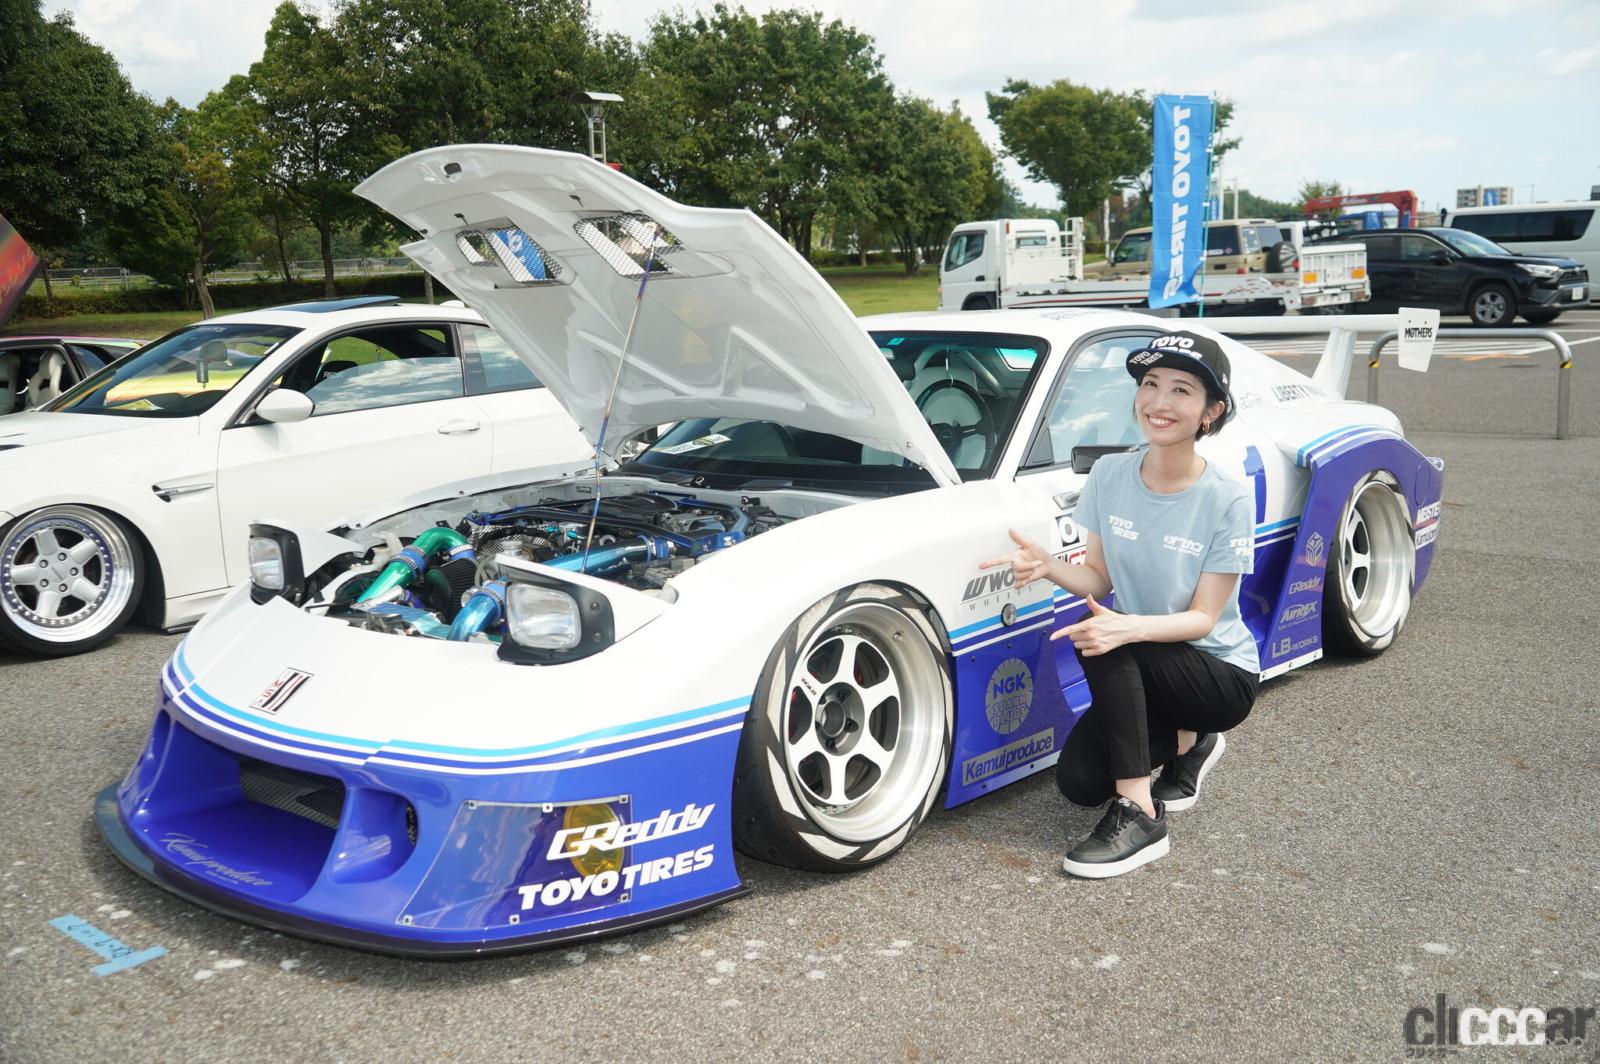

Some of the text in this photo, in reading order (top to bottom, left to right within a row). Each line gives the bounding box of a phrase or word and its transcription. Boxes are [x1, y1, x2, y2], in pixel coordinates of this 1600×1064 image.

[1404, 327, 1433, 339] MOTHERS
[1150, 335, 1195, 349] TOYO
[1128, 350, 1151, 365] TOYO
[1139, 351, 1164, 366] TIRES
[1108, 514, 1134, 530] TOYO
[1110, 525, 1140, 541] TIRES
[992, 671, 1027, 700] NGK
[965, 734, 1053, 781] Kamuiproduce
[517, 843, 715, 911] TOYO TIRES
